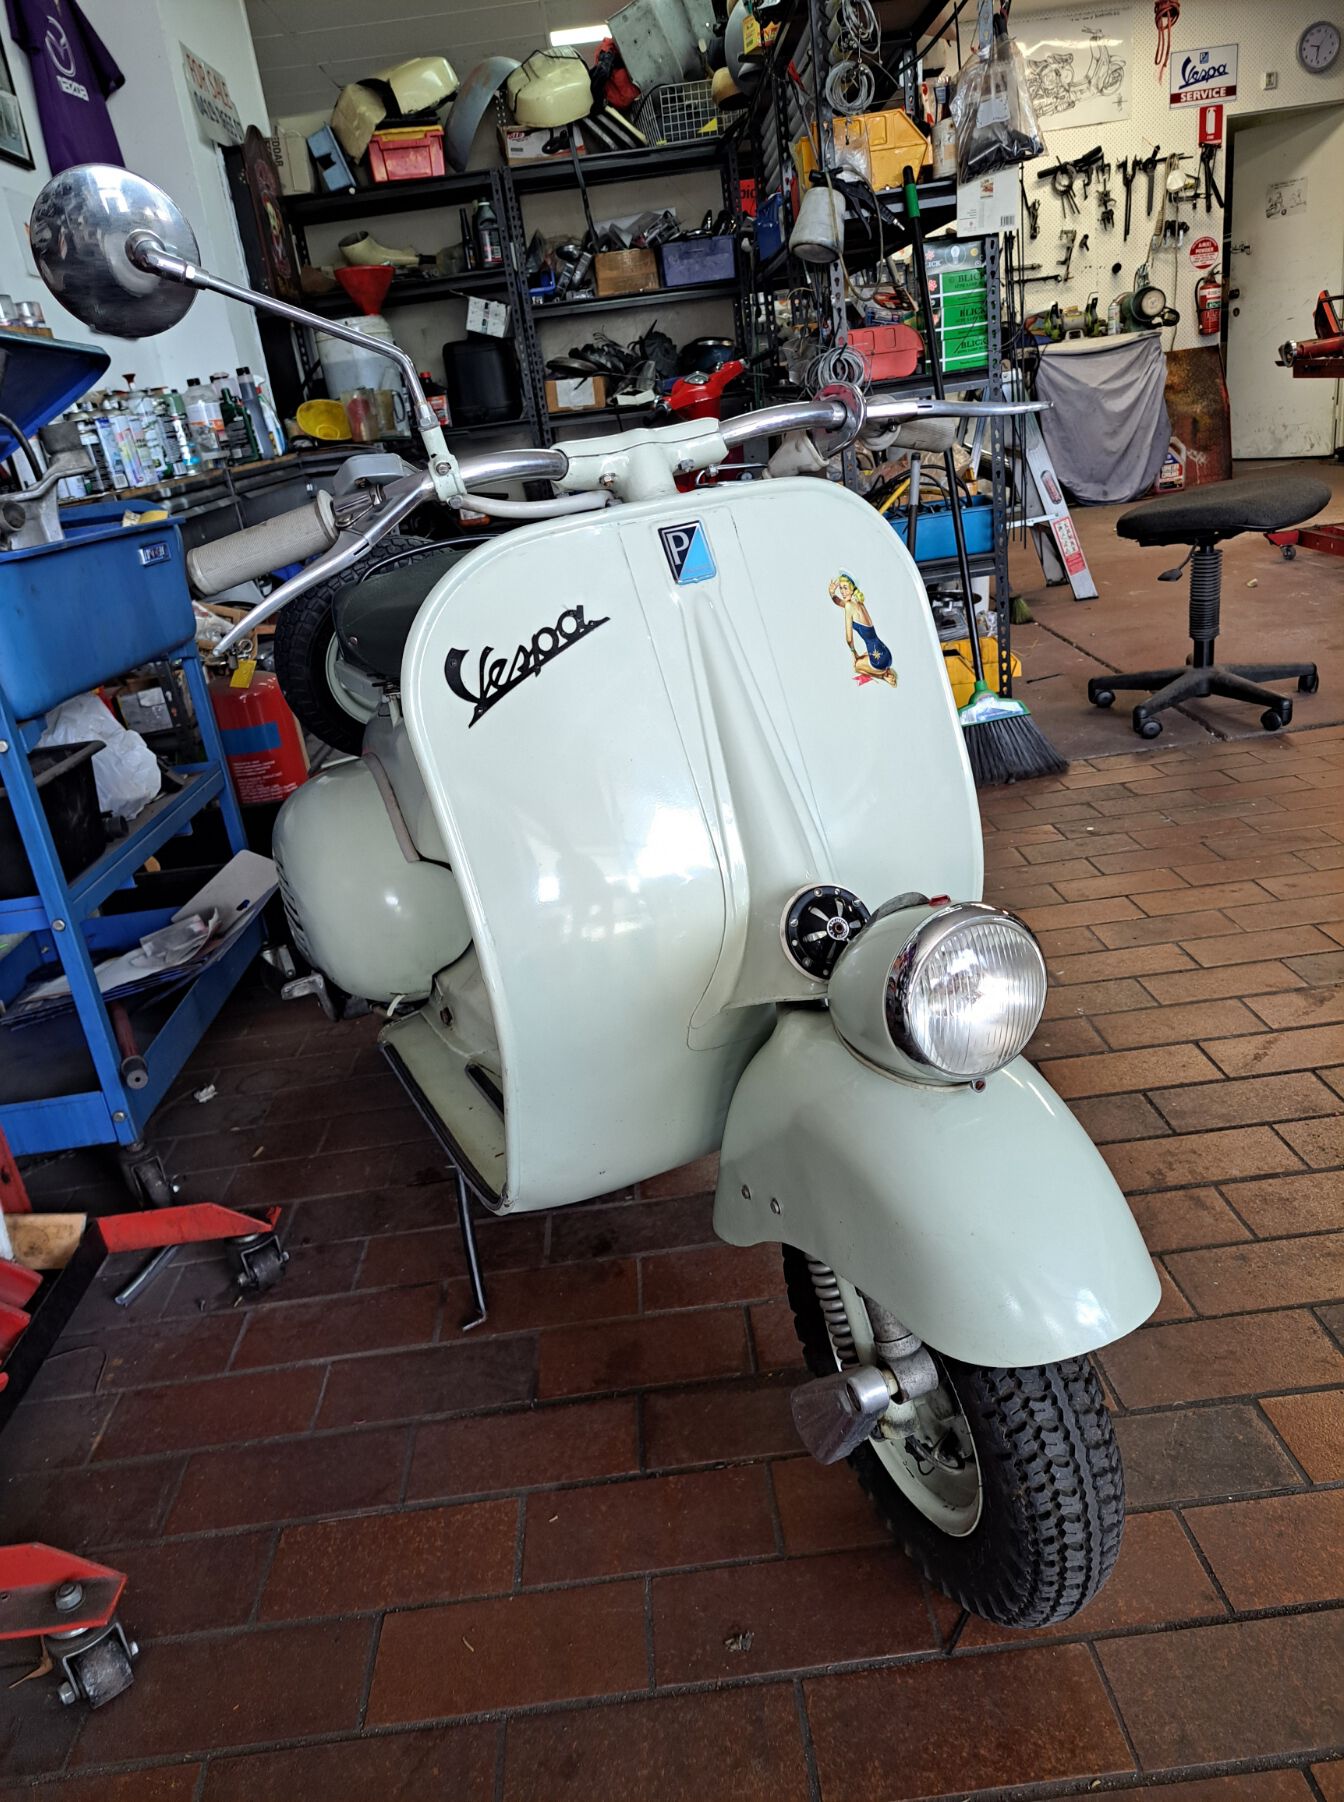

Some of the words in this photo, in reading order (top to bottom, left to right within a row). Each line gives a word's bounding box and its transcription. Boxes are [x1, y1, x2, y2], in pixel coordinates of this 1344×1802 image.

[1179, 56, 1229, 90] Vespa
[1180, 87, 1226, 102] SERVICE
[665, 531, 690, 566] P
[444, 605, 611, 729] Vespa
